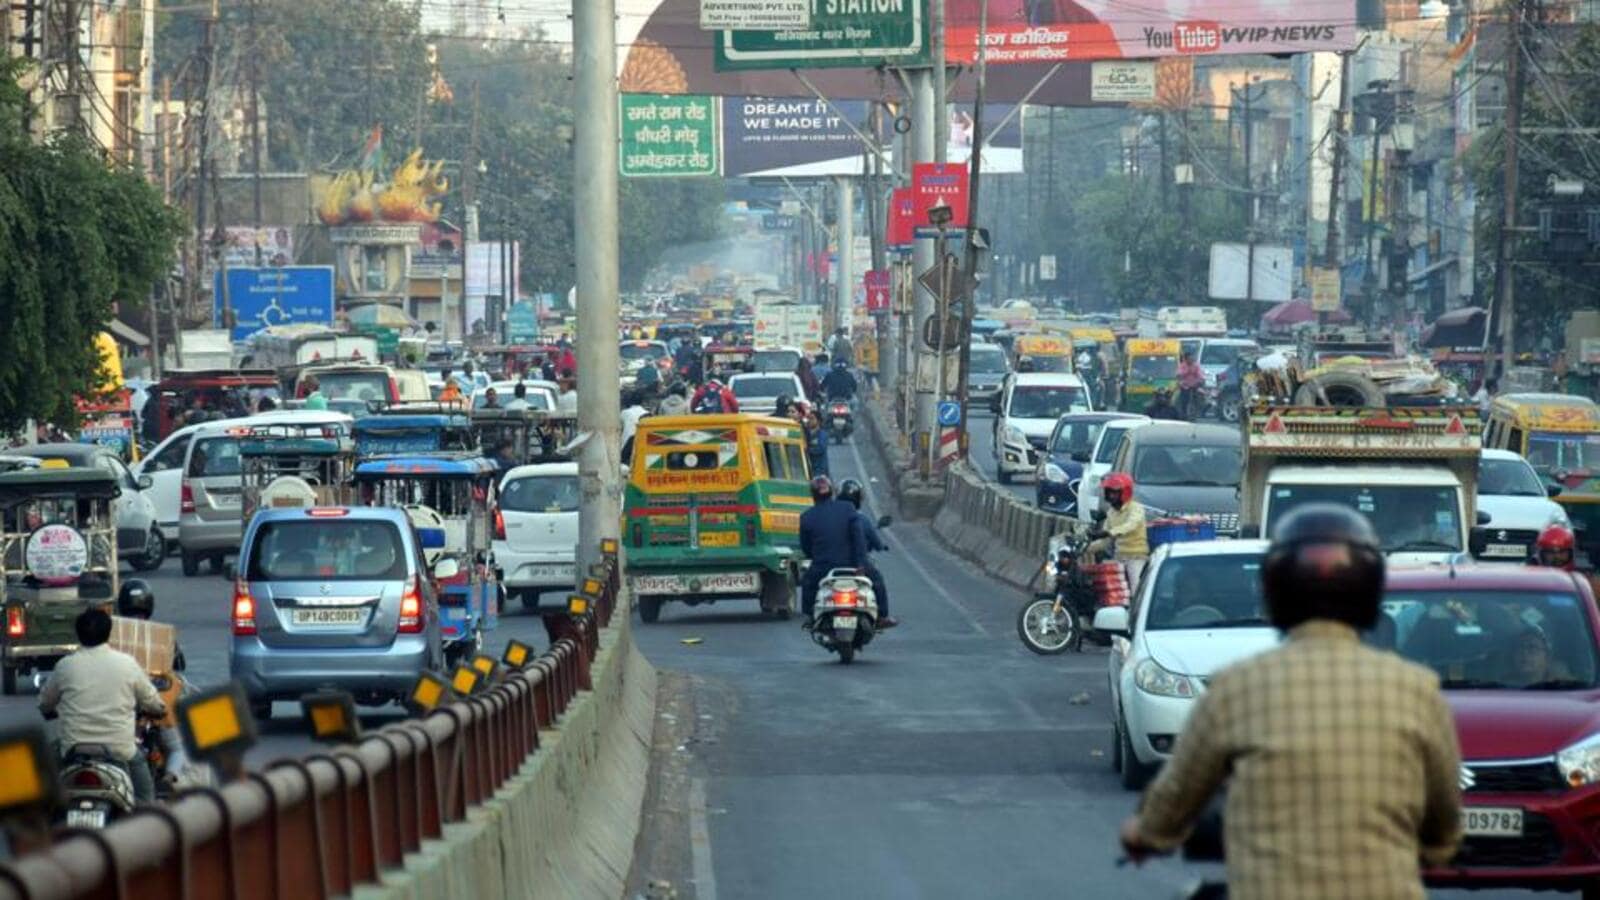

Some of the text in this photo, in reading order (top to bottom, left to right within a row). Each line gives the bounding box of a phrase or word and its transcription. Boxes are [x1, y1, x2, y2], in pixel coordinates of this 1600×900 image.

[1221, 27, 1268, 43] VVIP
[1271, 25, 1336, 42] NEWS
[743, 103, 811, 115] DREAMT
[743, 117, 840, 129] WE MADE IT
